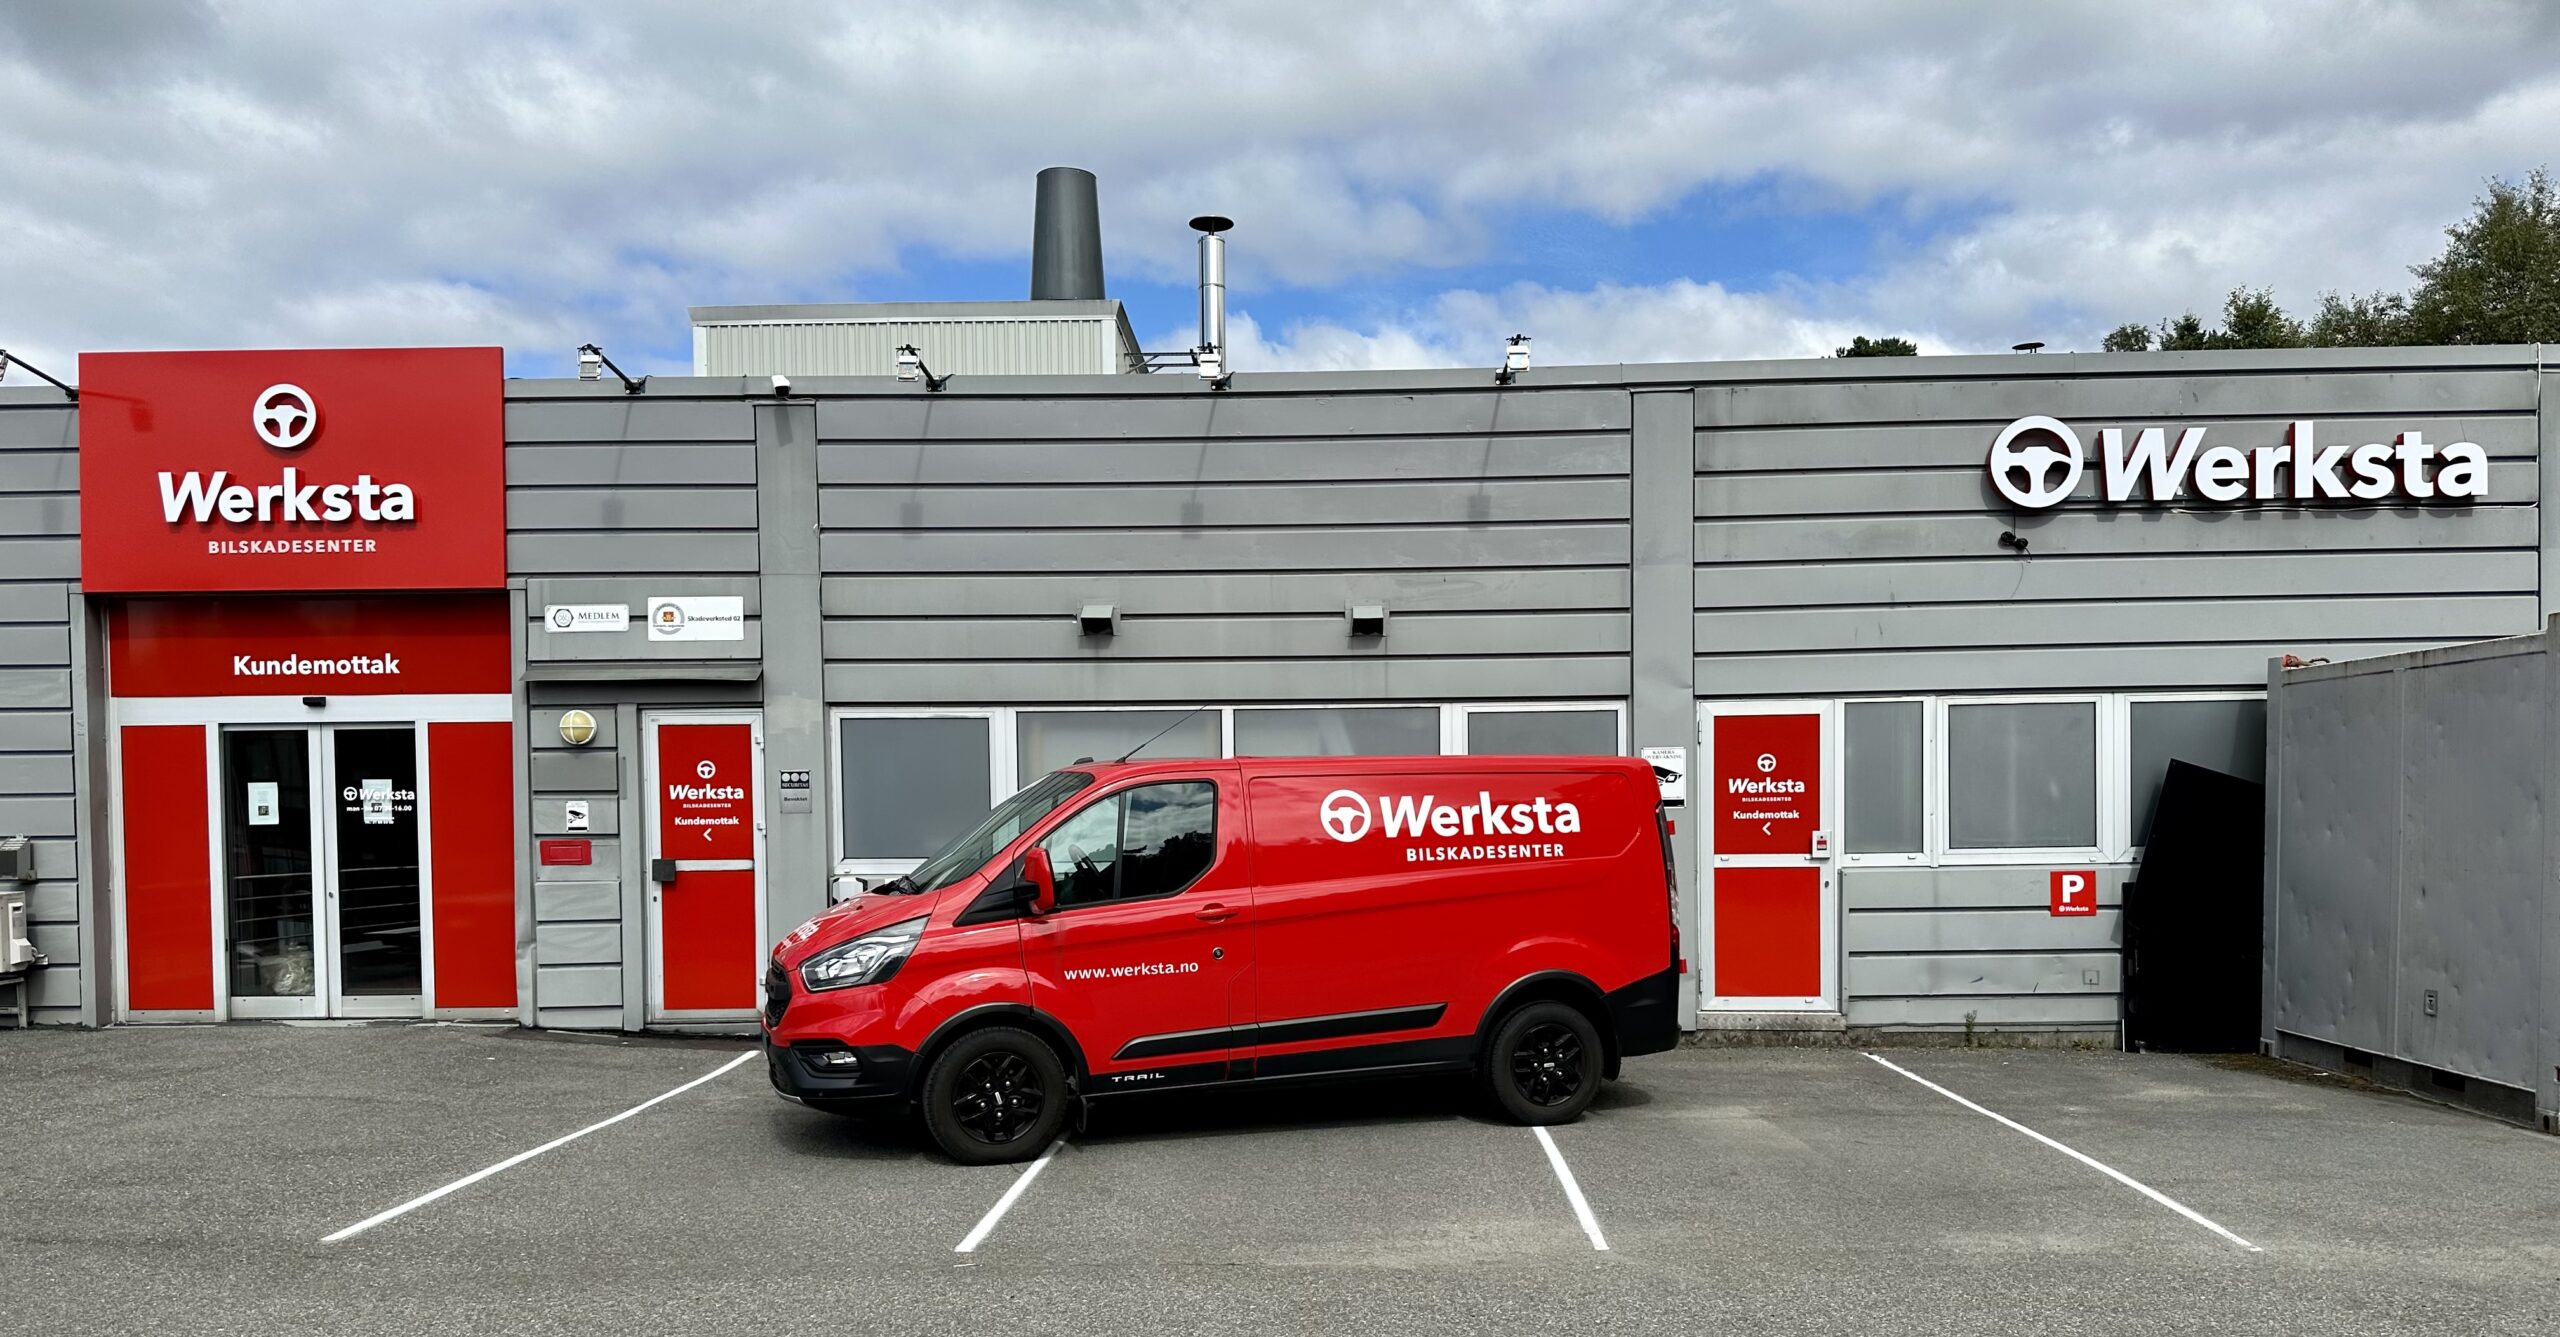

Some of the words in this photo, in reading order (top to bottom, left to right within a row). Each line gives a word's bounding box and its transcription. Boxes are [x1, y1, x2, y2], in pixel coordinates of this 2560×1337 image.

[2101, 420, 2489, 501] Werksta
[158, 467, 414, 523] Werksta
[208, 539, 377, 554] BILSKADESENTER
[578, 611, 620, 620] MEDLEM
[234, 653, 400, 676] Kundemottak
[669, 783, 744, 800] Werksta
[1728, 777, 1805, 793] Werksta
[359, 788, 415, 800] Werksta
[674, 816, 740, 826] Kundemottak
[1379, 791, 1581, 838] Werksta
[1733, 810, 1800, 819] Kundemottak
[1406, 843, 1565, 862] BILSKADESENTER
[2062, 874, 2085, 903] P
[1064, 962, 1199, 980] www.werksta.no
[1112, 1072, 1165, 1083] TRAIL
